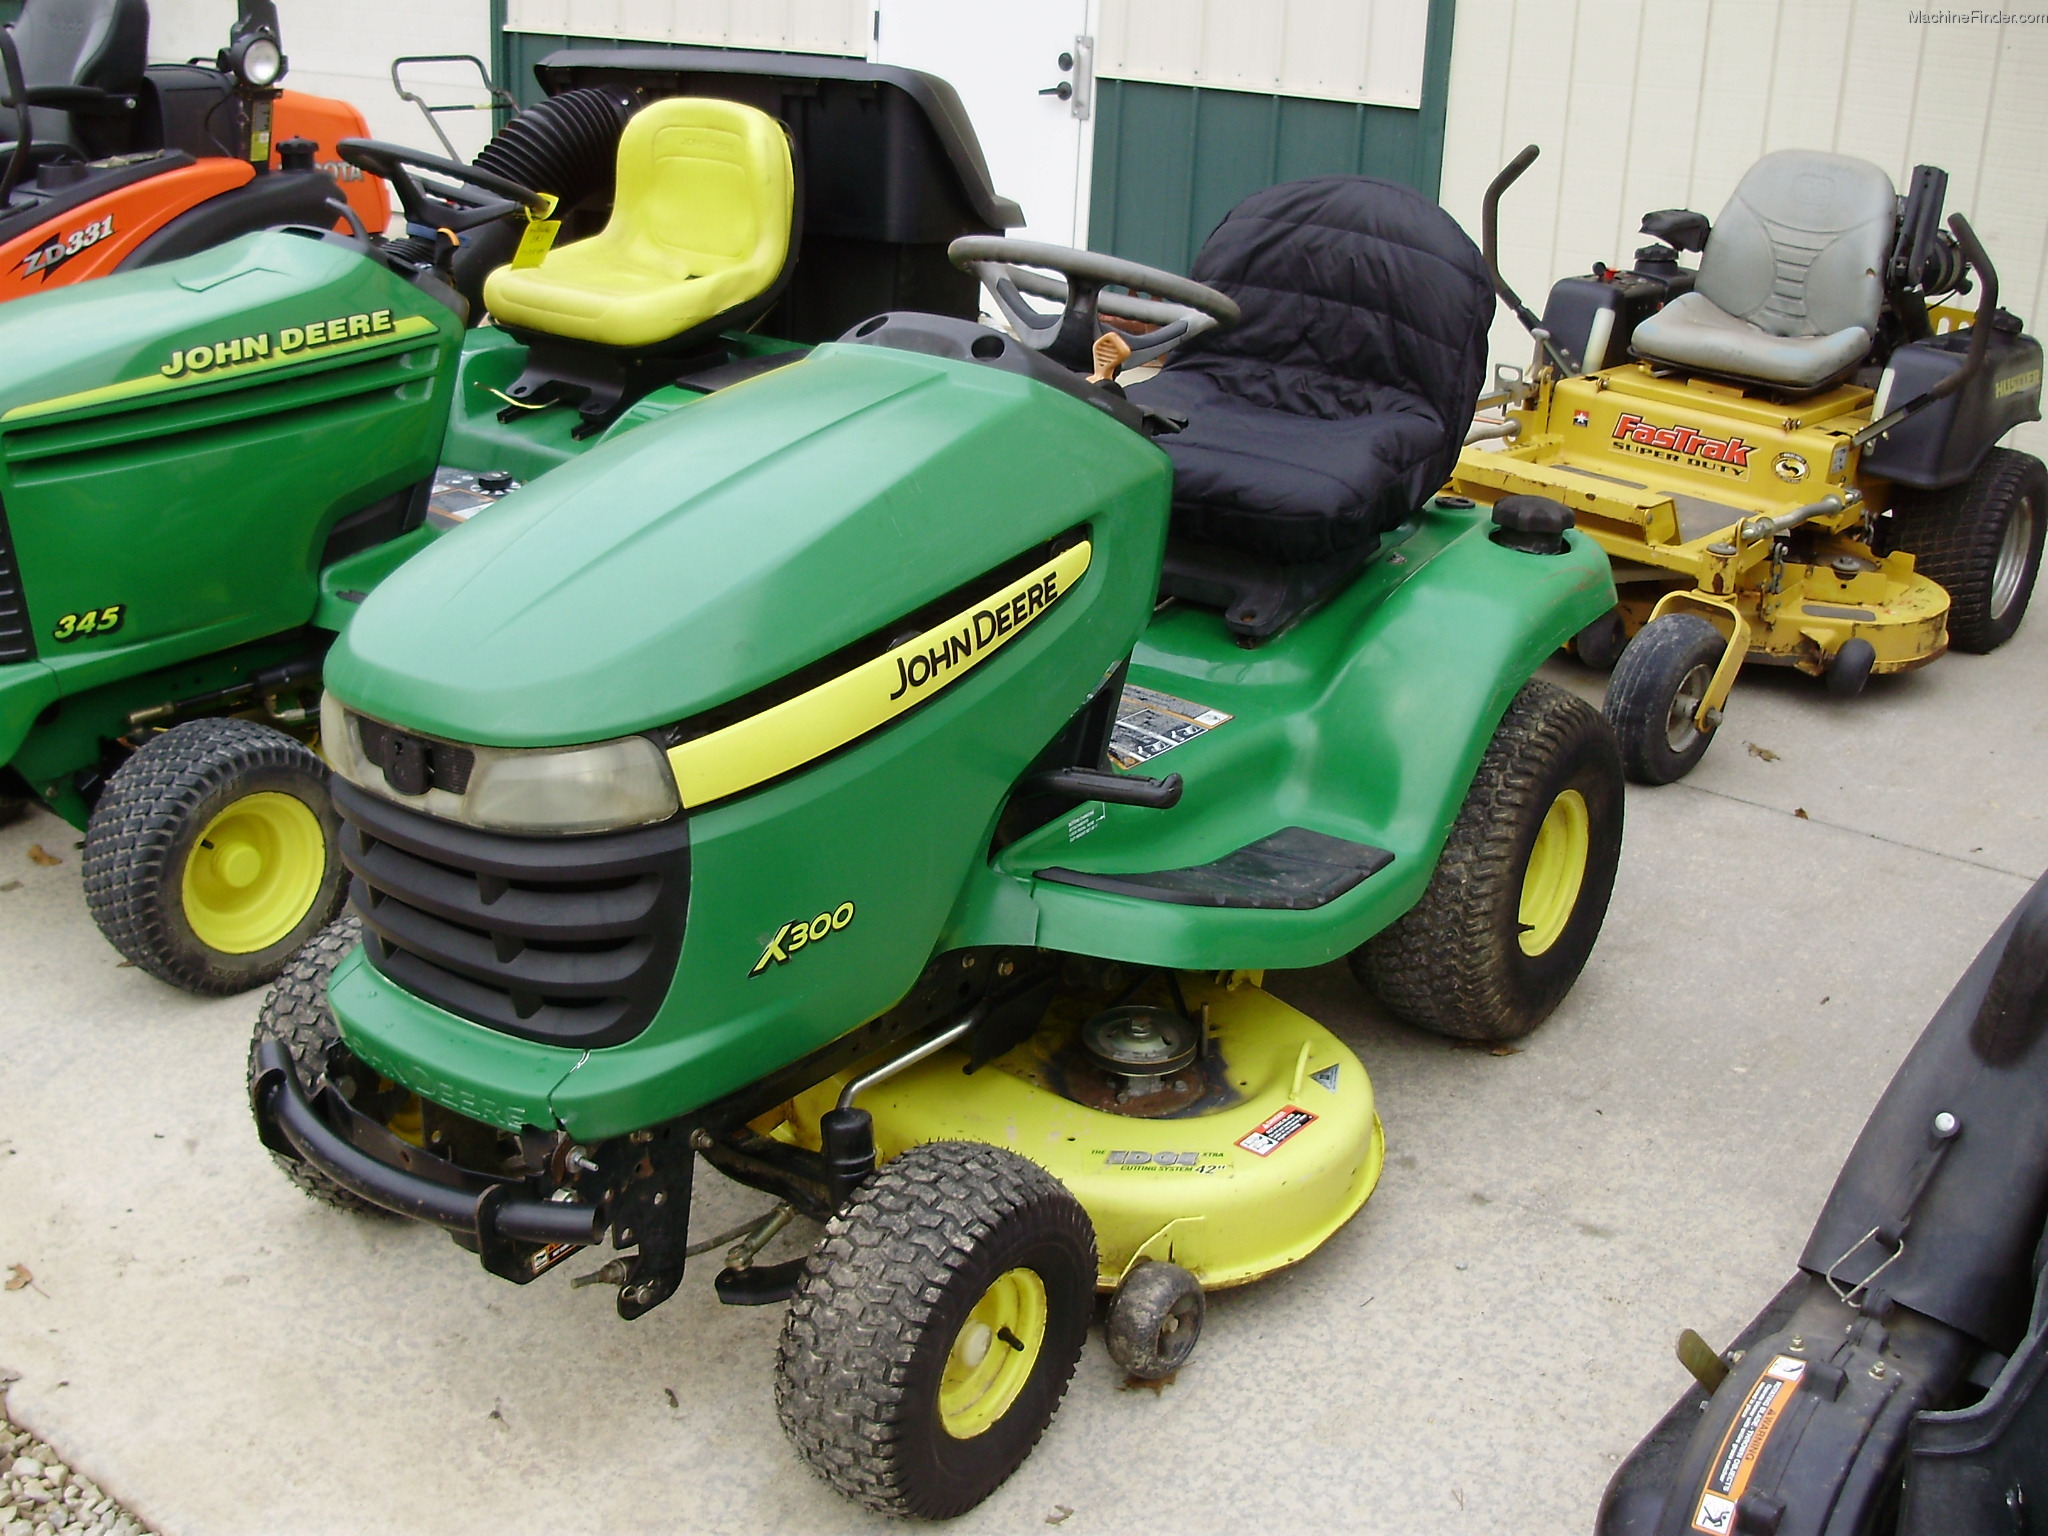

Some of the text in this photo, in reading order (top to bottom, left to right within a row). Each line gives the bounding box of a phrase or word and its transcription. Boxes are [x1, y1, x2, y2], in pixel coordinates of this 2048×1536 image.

[22, 213, 114, 279] ZD331
[160, 309, 393, 377] JOHN DEERE
[1612, 413, 1757, 467] FasTrak
[1613, 441, 1745, 476] SUPER DUTY
[54, 605, 124, 642] 345
[890, 571, 1058, 701] JOHN DEERE
[748, 900, 855, 978] X300
[1105, 1150, 1199, 1166] EDGE
[1745, 1414, 1774, 1461] WARNING
[1722, 1458, 1740, 1491] OBJECTS
